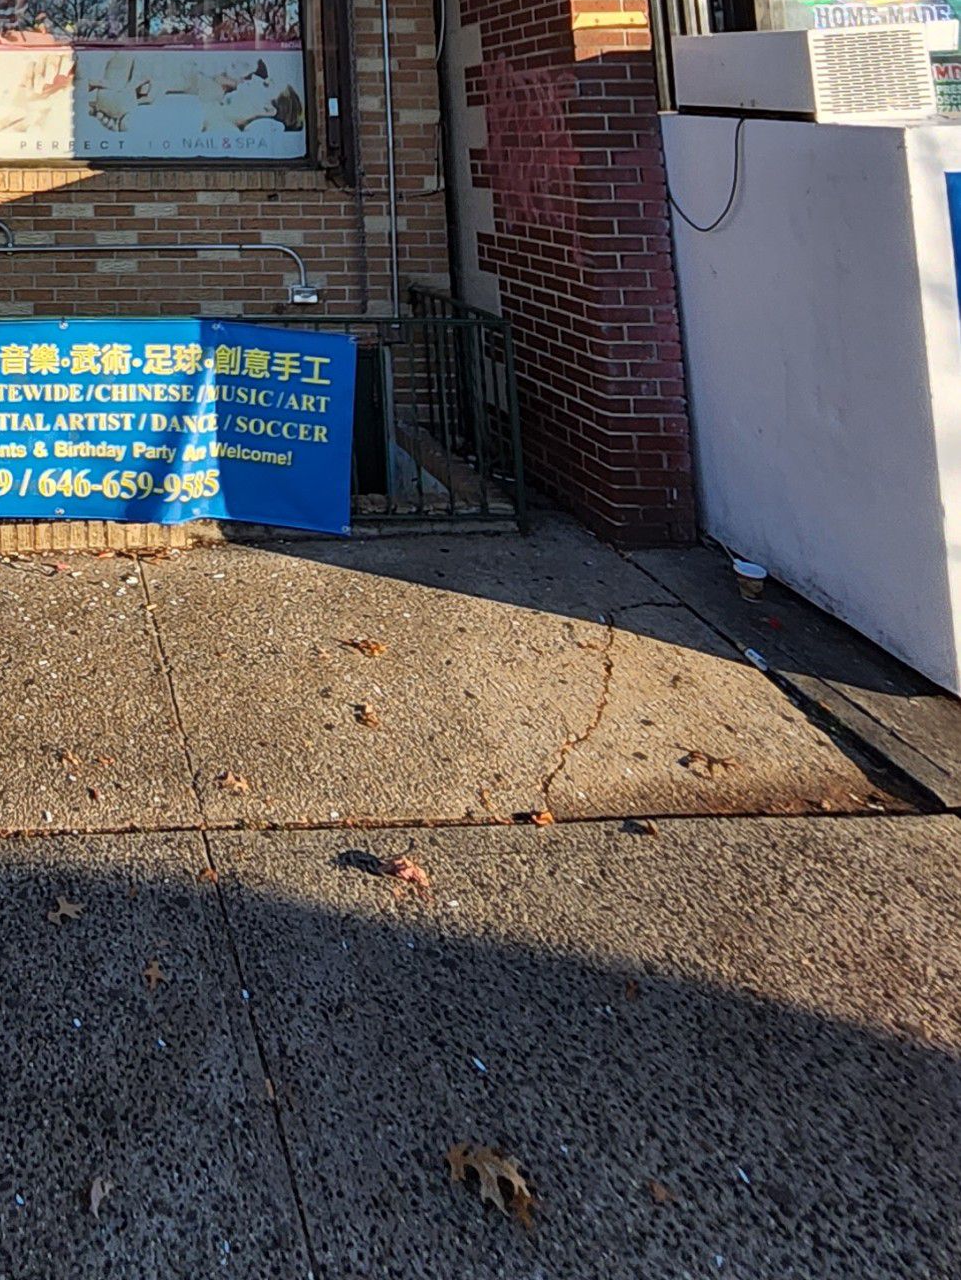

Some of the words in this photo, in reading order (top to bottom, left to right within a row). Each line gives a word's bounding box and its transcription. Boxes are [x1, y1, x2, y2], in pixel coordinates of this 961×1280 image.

[19, 140, 126, 151] PERFECT
[182, 136, 217, 150] NAIL
[221, 136, 232, 149] &
[235, 136, 269, 150] SPA
[52, 413, 135, 431] ARTIST
[235, 415, 330, 443] SOCCER
[32, 441, 48, 458] &
[54, 441, 126, 462] Birthday
[132, 441, 177, 463] Party
[209, 440, 294, 466] Welcome!
[38, 468, 221, 503] 646-659-9585
